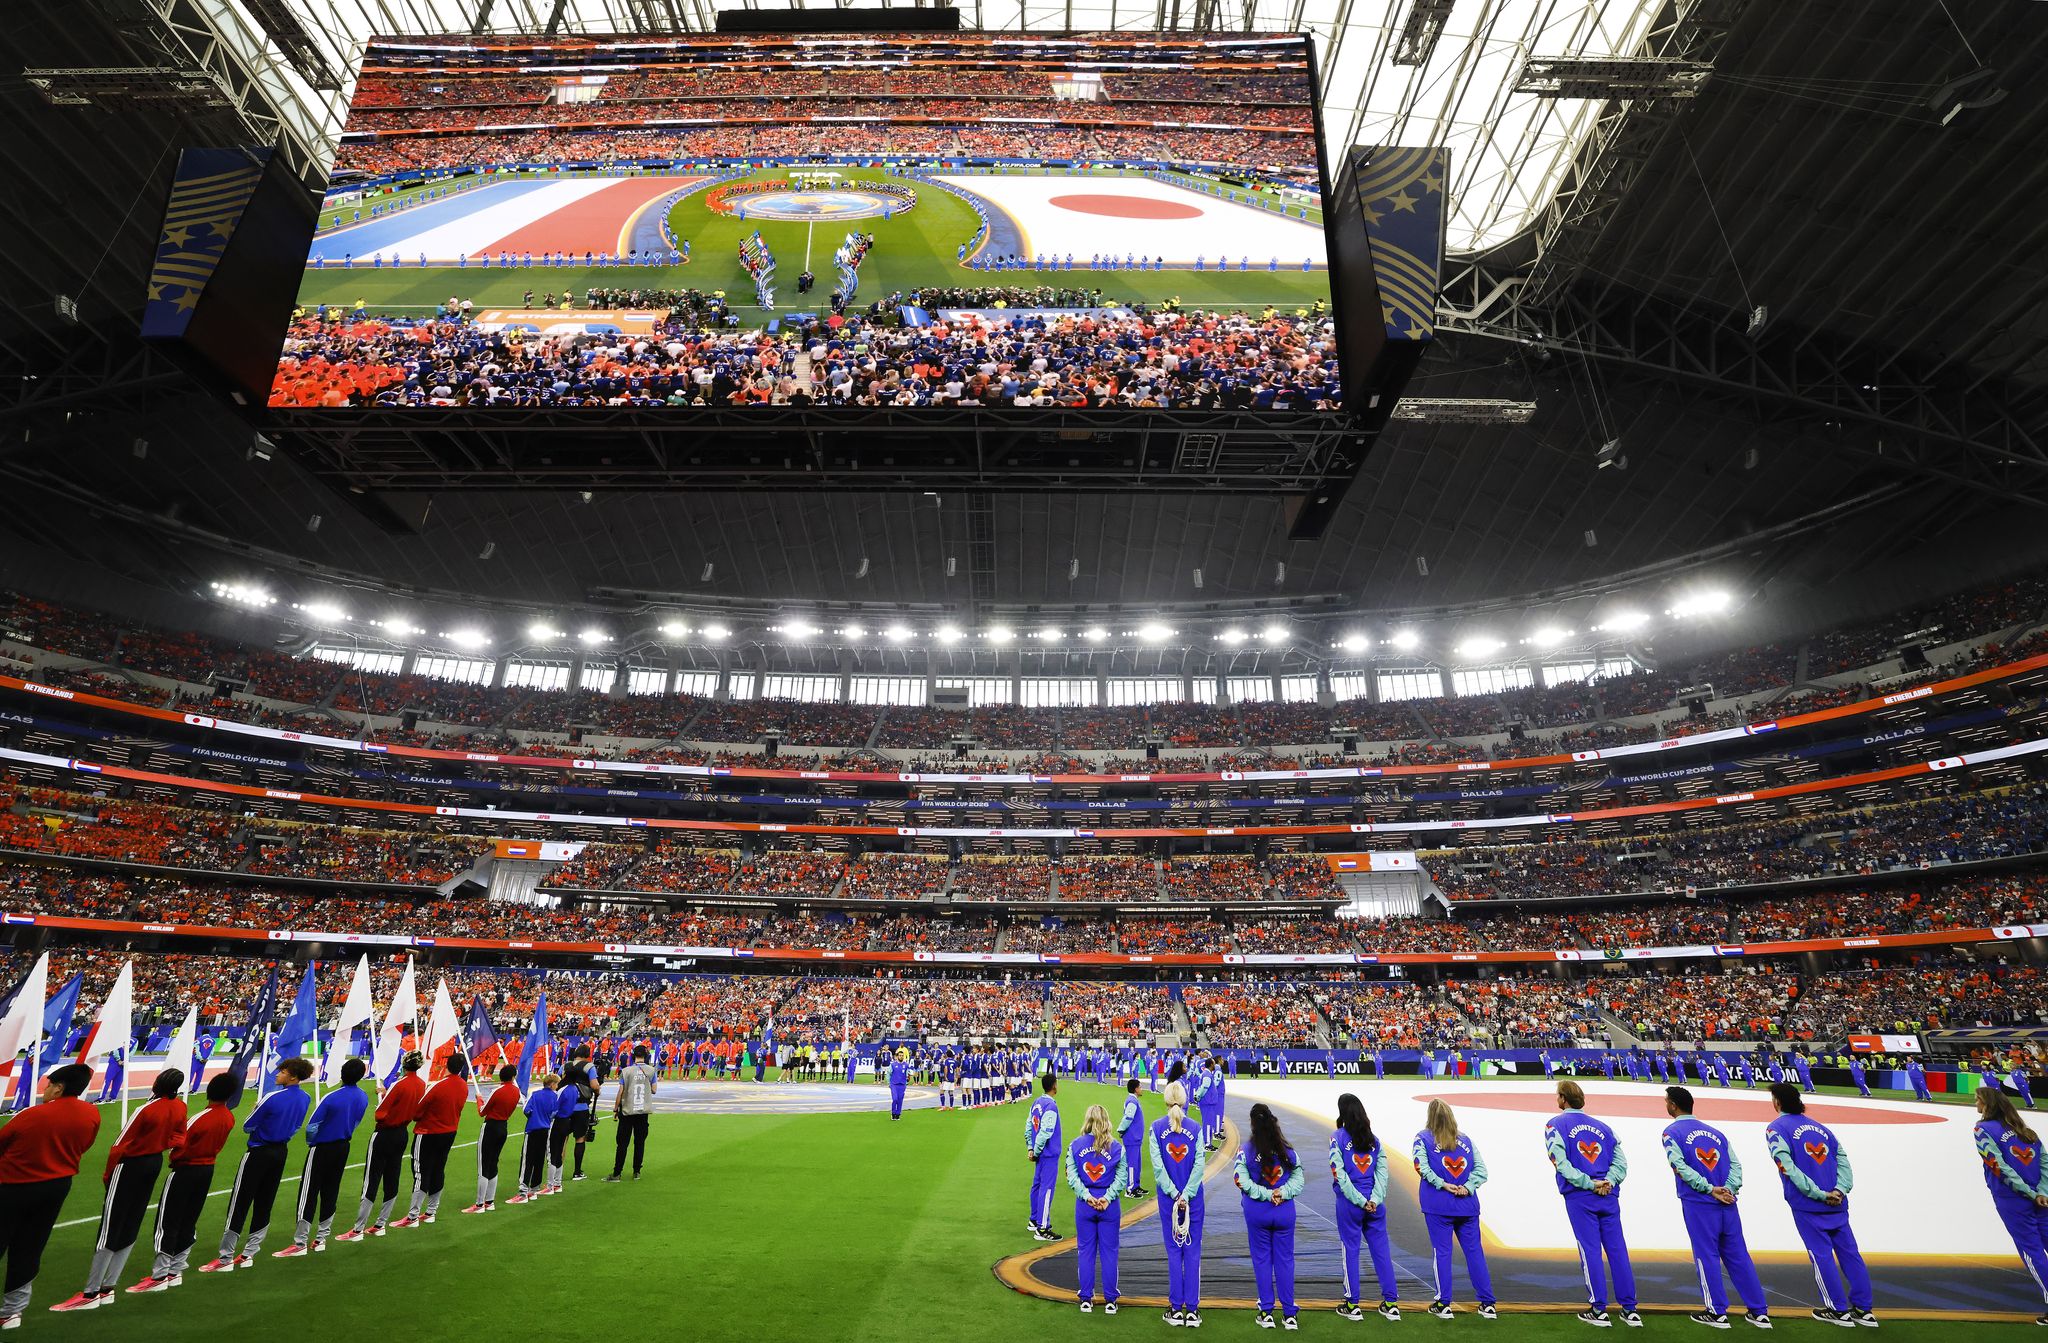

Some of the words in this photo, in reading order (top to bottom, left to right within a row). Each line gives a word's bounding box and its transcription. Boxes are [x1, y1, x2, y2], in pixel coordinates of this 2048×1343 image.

[24, 683, 74, 700] NETHERLANDS
[1883, 687, 1933, 705] NETHERLANDS
[281, 732, 300, 741] JAPAN
[1863, 726, 1926, 745] DALLAS
[1660, 740, 1679, 749] JAPAN
[193, 747, 210, 756] FIFA
[212, 751, 241, 760] WORLD
[243, 755, 259, 763] CUP
[259, 758, 288, 767] 2026
[466, 753, 498, 762] NETHERLANDS
[410, 776, 453, 785] DALLAS
[1623, 776, 1639, 784] FIFA
[1640, 773, 1668, 781] WORLD
[1669, 770, 1684, 778] CUP
[1685, 765, 1715, 774] 2026
[266, 790, 301, 800] NETHERLANDS
[1461, 790, 1503, 798] DALLAS
[1716, 793, 1753, 804] NETHERLANDS
[1260, 1062, 1360, 1074] PLY.FIFA.OM
[1706, 1065, 1800, 1083] PLY.FA.CM
[1160, 1128, 1195, 1141] VOLTEER
[1568, 1124, 1606, 1140] VOLUNTEER
[1685, 1130, 1722, 1145] VOLUNTEER
[1793, 1124, 1829, 1140] VOLUNTEER
[1078, 1147, 1113, 1161] VOLUEER
